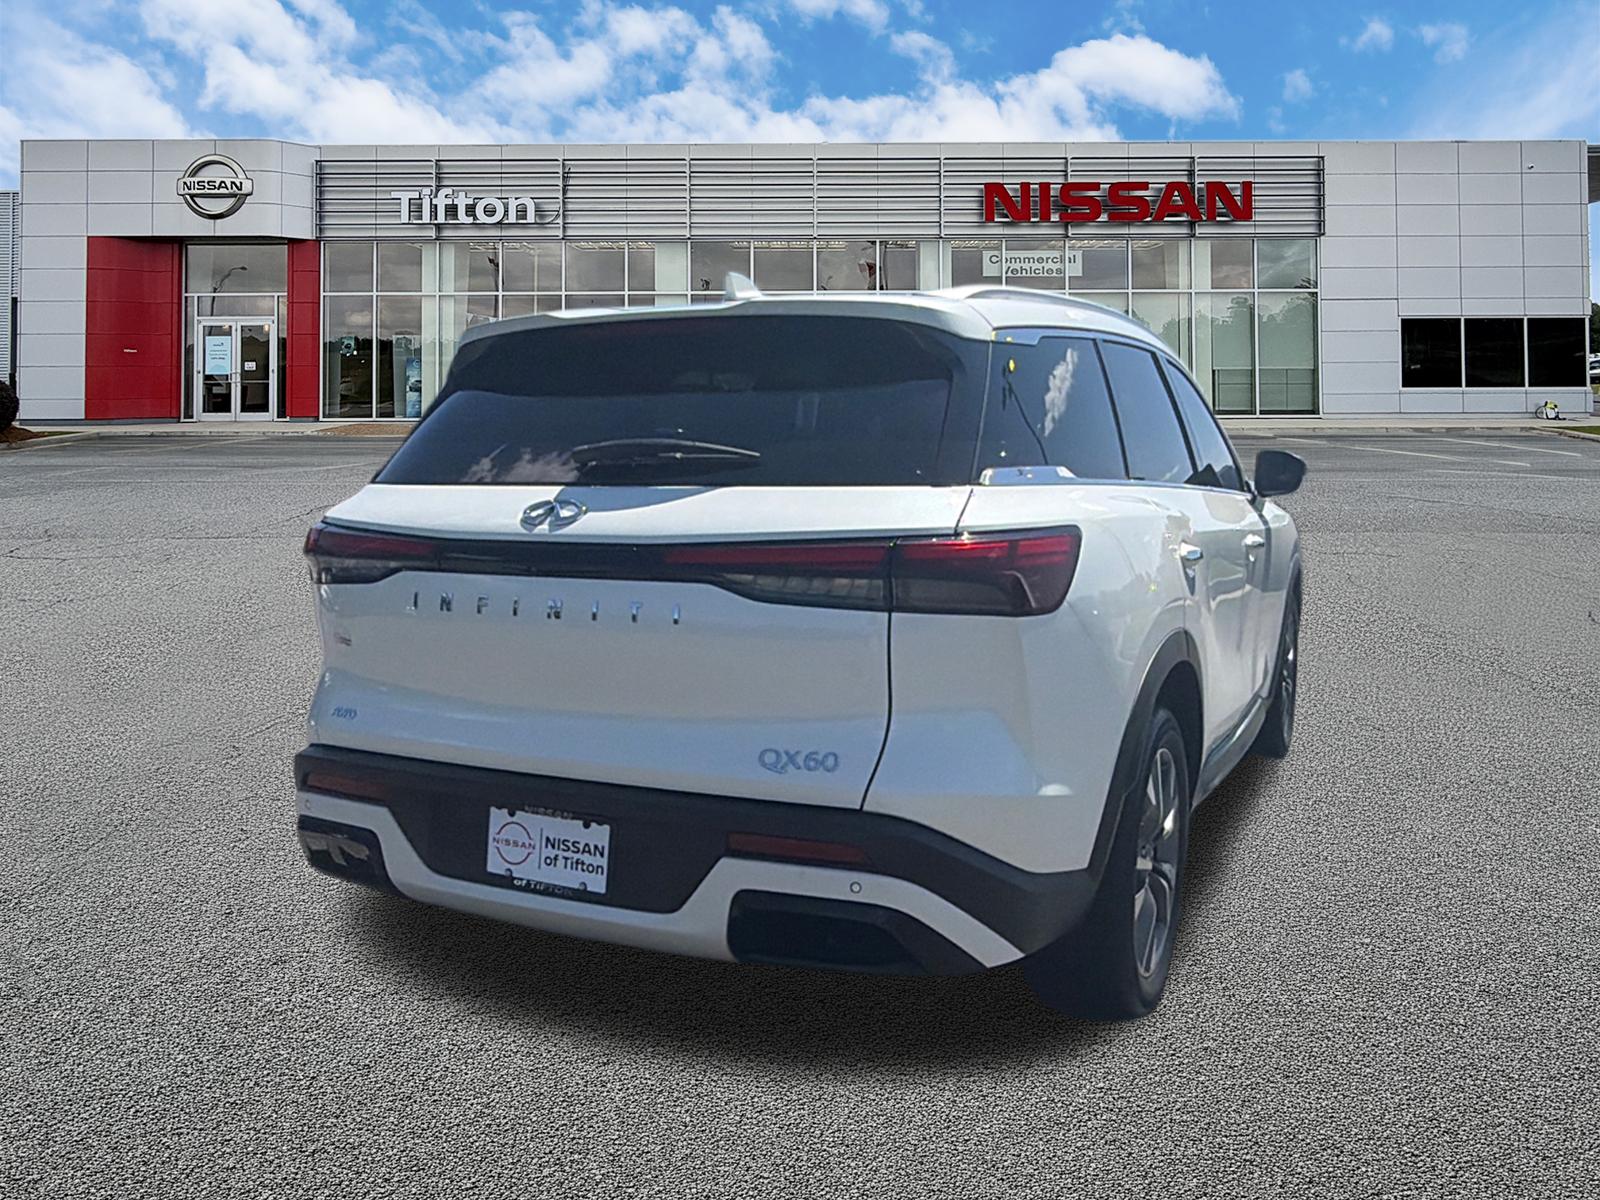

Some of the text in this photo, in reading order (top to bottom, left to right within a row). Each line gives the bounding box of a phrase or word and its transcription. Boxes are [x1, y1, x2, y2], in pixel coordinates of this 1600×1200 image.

[182, 180, 244, 192] NISSAN
[391, 188, 536, 224] Tifton
[983, 181, 1253, 223] NISSAN
[411, 591, 681, 625] INFINITI
[758, 748, 839, 774] QX60
[492, 837, 536, 850] NISSAN
[545, 836, 605, 858] NISSAN
[544, 854, 605, 876] of Tifton
